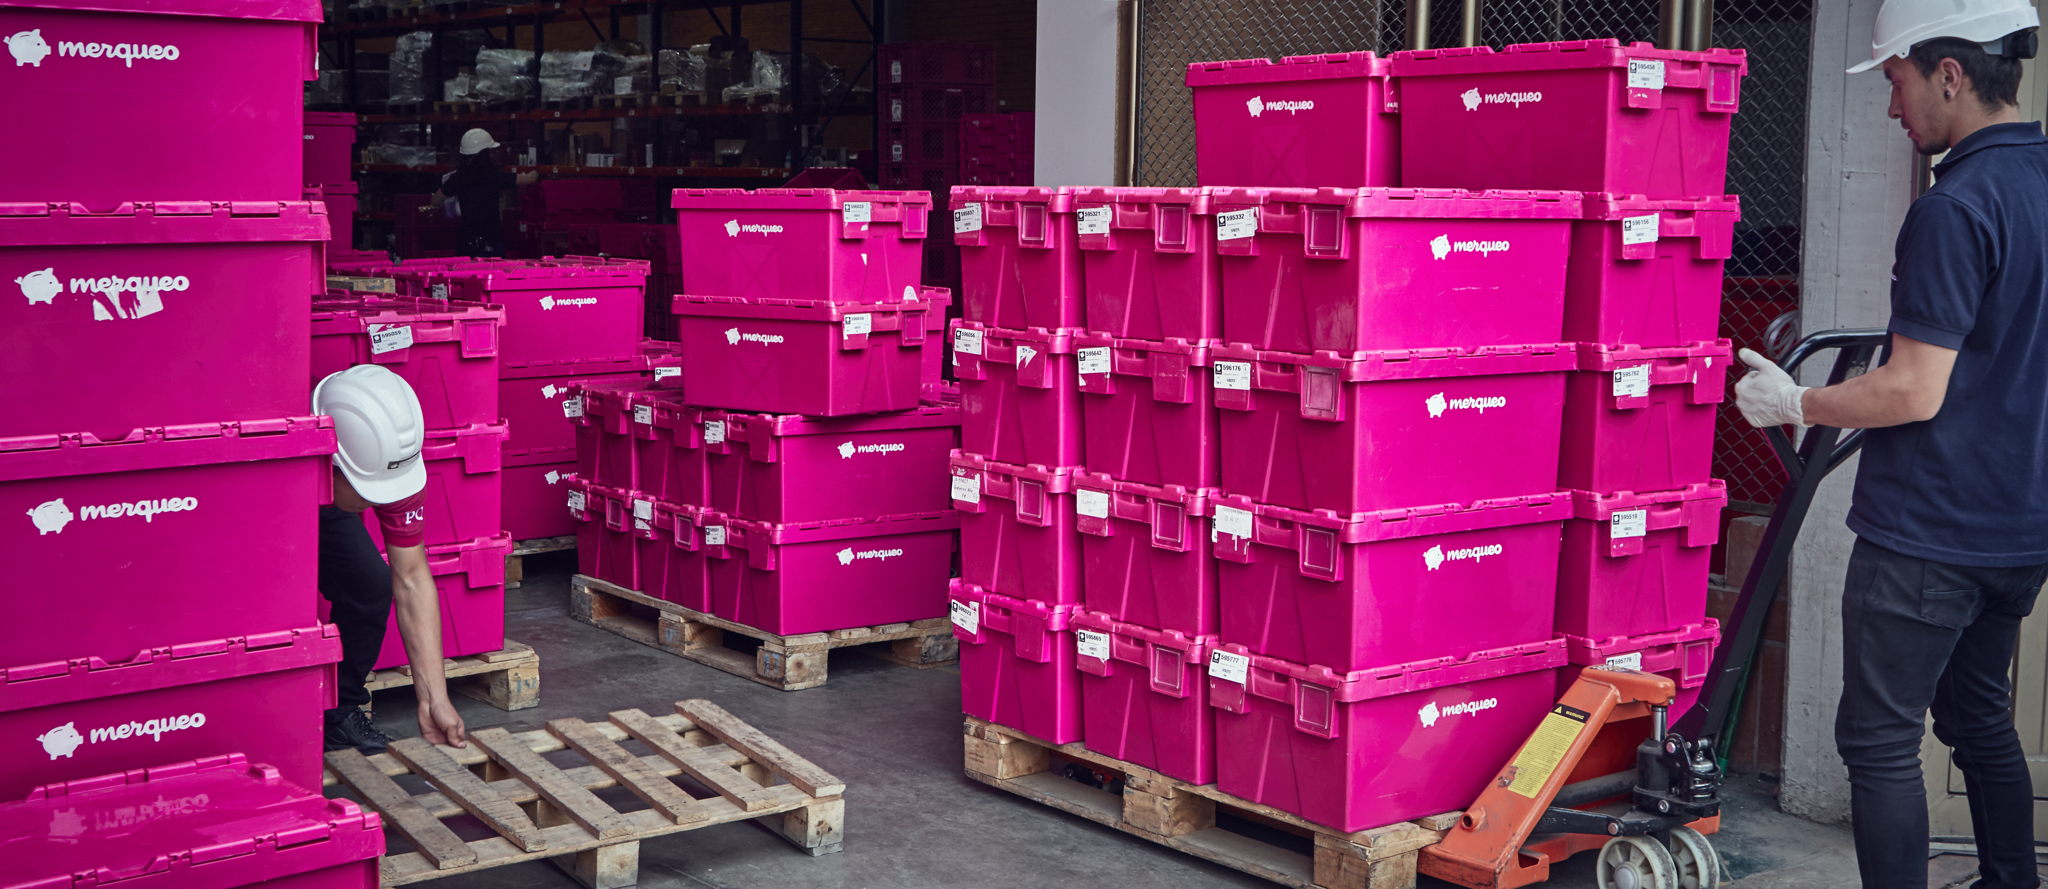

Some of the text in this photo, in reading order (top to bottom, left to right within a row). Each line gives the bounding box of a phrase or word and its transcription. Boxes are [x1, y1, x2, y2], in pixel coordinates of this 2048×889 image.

[58, 40, 180, 68] merqueo
[1266, 100, 1315, 115] merqueo
[1485, 91, 1543, 108] merqueo
[741, 223, 784, 236] merqueo
[1453, 239, 1510, 257] merqueo
[69, 275, 190, 299] merqueo
[556, 296, 598, 307] merqueo
[741, 332, 784, 347] merqueo
[1450, 396, 1507, 414] merqueo
[857, 443, 905, 456] merqueo
[80, 496, 198, 522] merqueo
[856, 547, 903, 561] merqueo
[1447, 543, 1502, 562] merqueo
[1441, 698, 1498, 717] merqueo
[90, 712, 206, 744] merqueo
